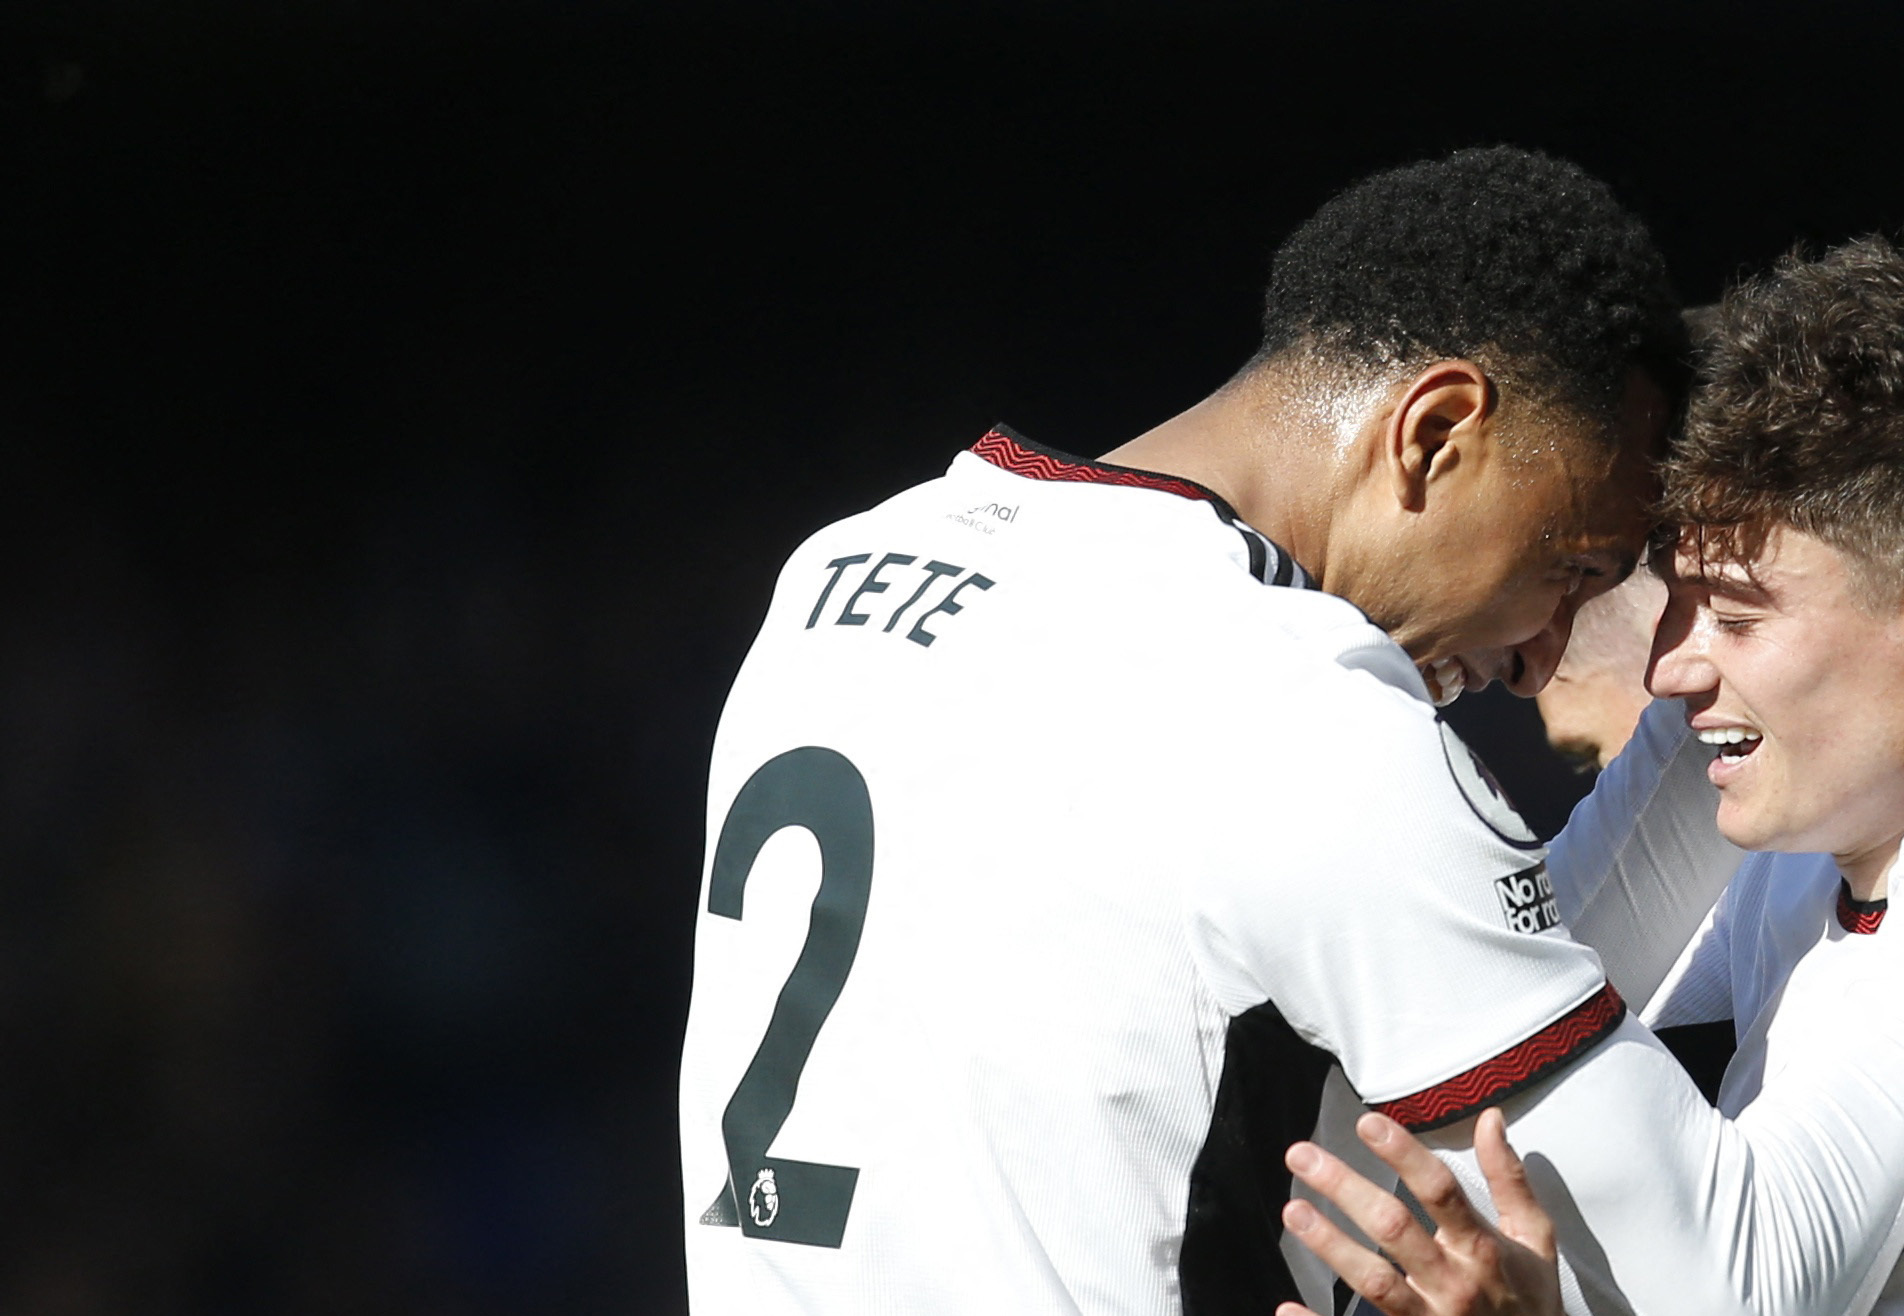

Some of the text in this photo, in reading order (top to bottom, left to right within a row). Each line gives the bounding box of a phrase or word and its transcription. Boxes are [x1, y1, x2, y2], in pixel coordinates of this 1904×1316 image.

[804, 552, 997, 648] TETE
[1496, 875, 1536, 910] No
[700, 745, 875, 1249] 2
